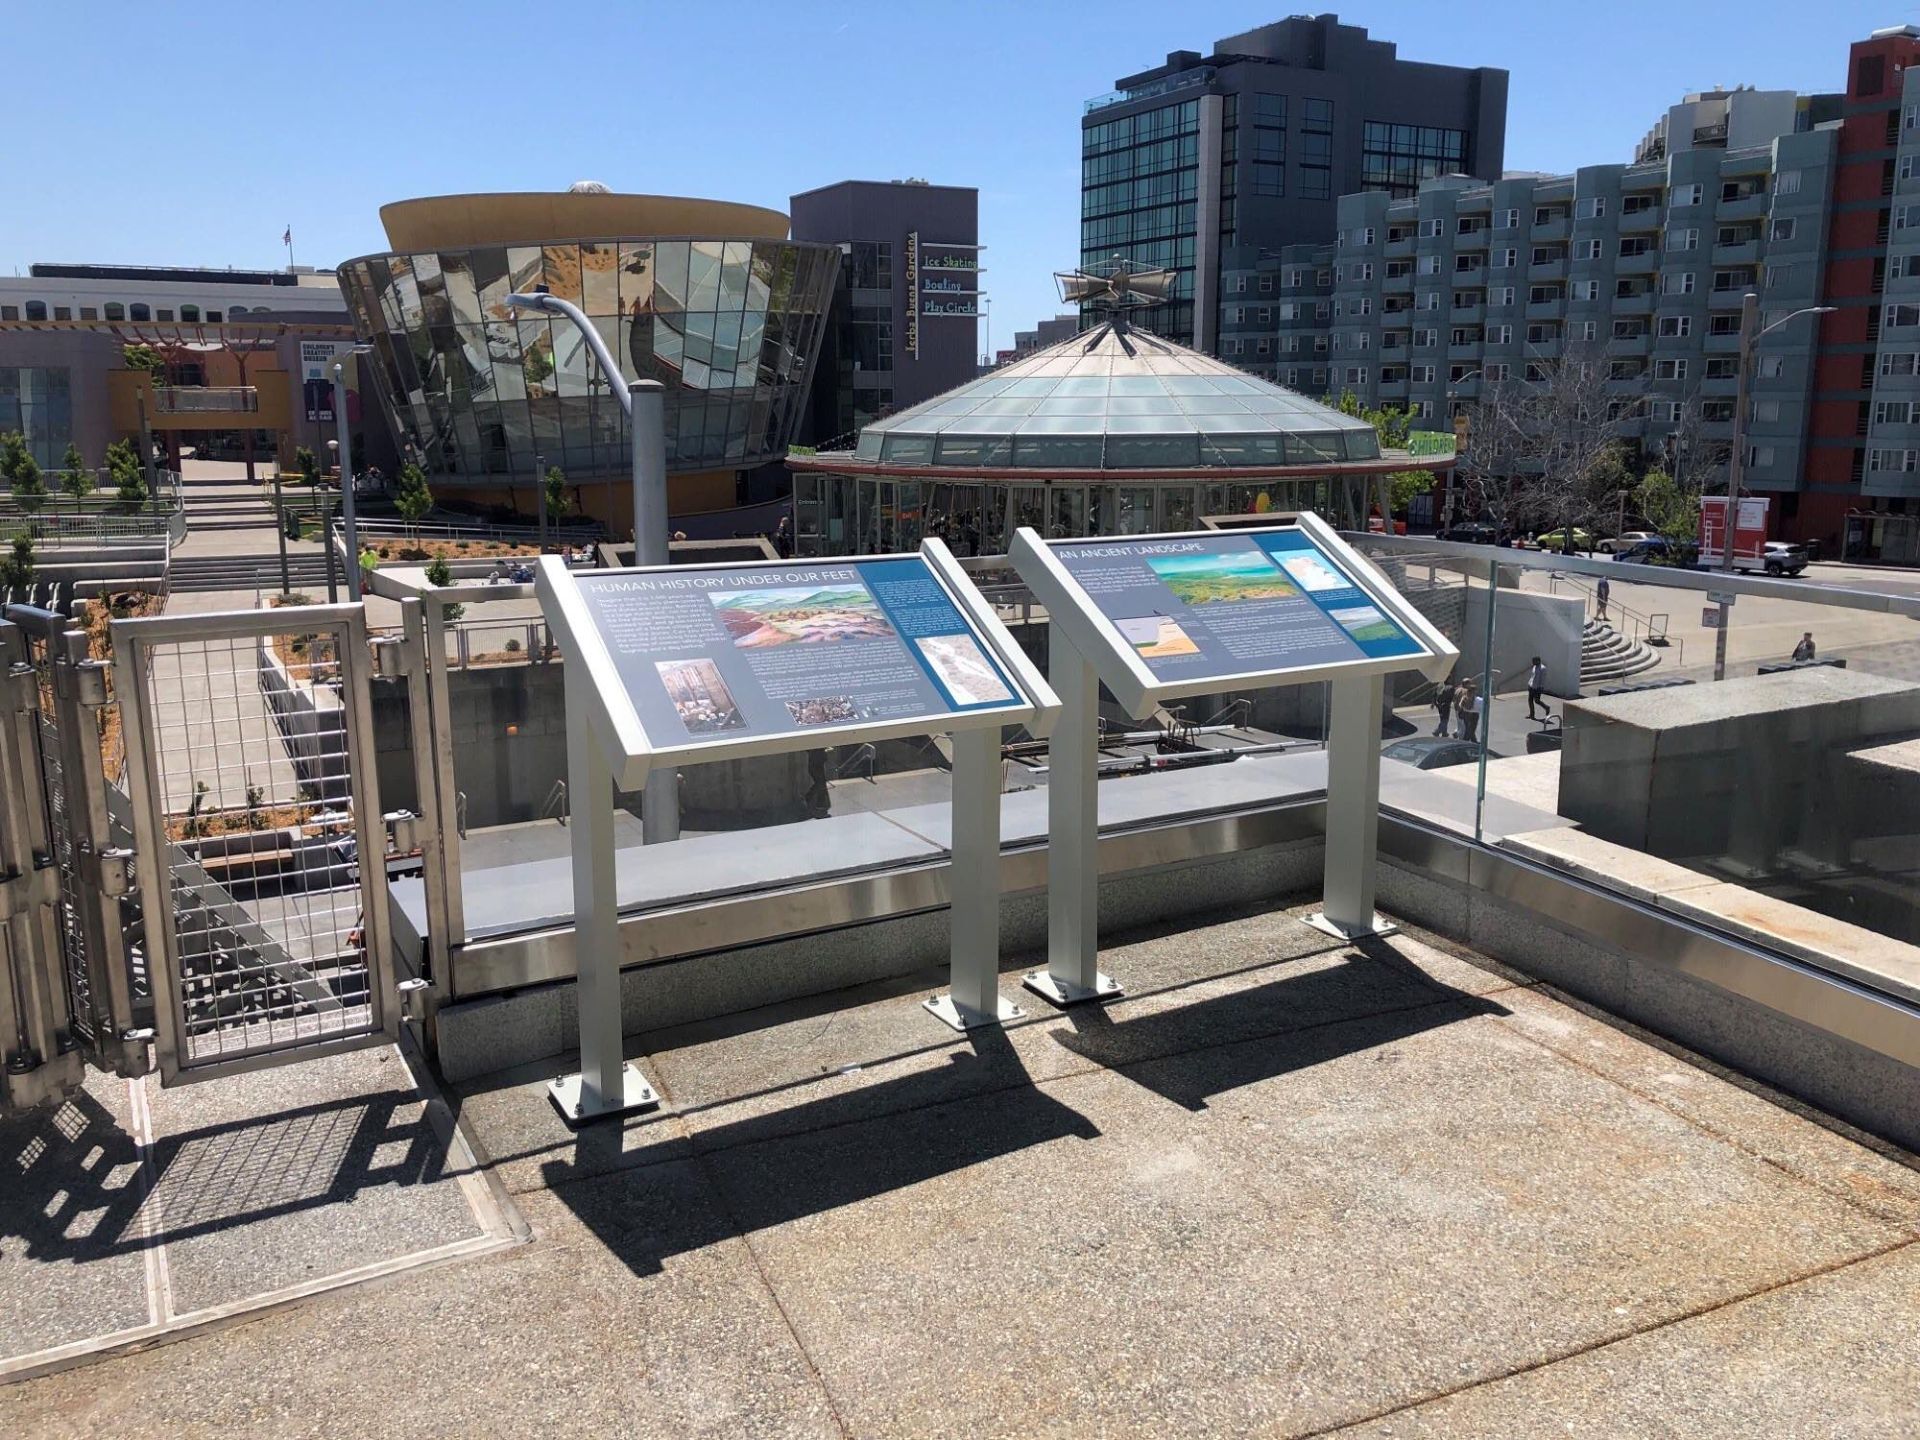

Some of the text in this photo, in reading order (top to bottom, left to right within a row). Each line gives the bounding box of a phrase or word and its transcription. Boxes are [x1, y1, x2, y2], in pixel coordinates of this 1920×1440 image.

[904, 232, 916, 280] Gardens
[924, 254, 978, 273] Ice Skating
[924, 278, 961, 295] Bowling
[906, 285, 915, 317] Buena
[924, 300, 977, 317] Play Circle
[1060, 543, 1205, 559] AN ANCIENT LANDSCAPE
[590, 570, 855, 593] HUMAN HISTORY UNDER OUR FEET
